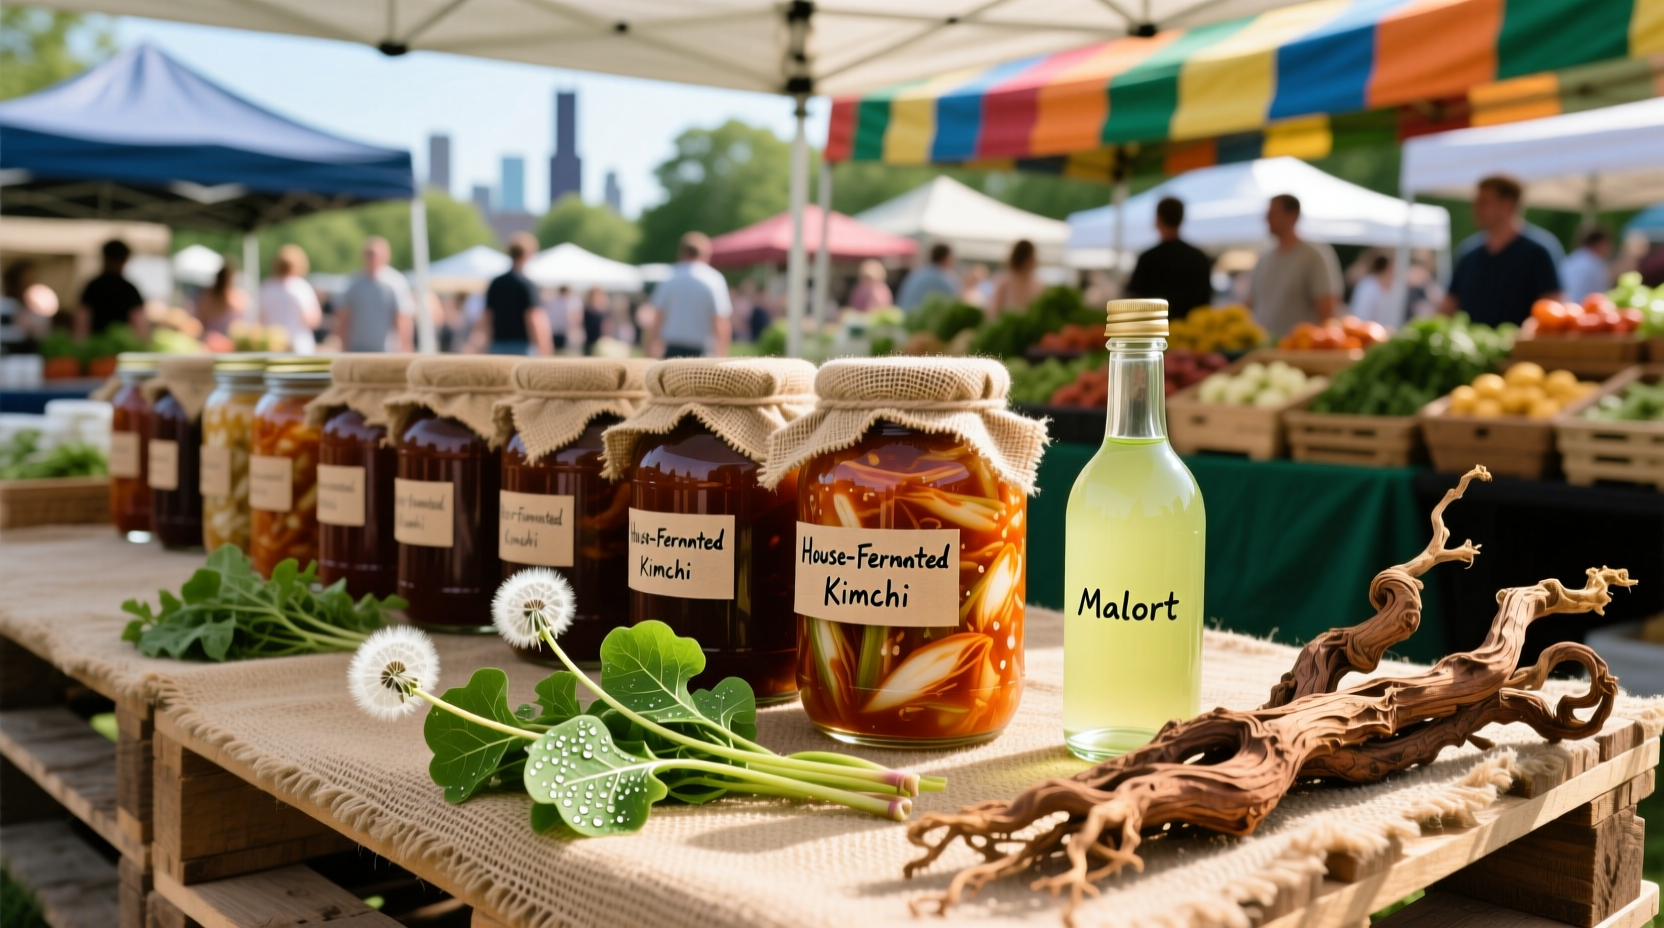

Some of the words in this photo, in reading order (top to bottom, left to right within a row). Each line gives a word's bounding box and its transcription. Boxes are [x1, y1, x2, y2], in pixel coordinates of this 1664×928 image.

[640, 555, 691, 580] Kimchi
[824, 575, 909, 608] Kimchi
[1077, 587, 1180, 621] Malort
